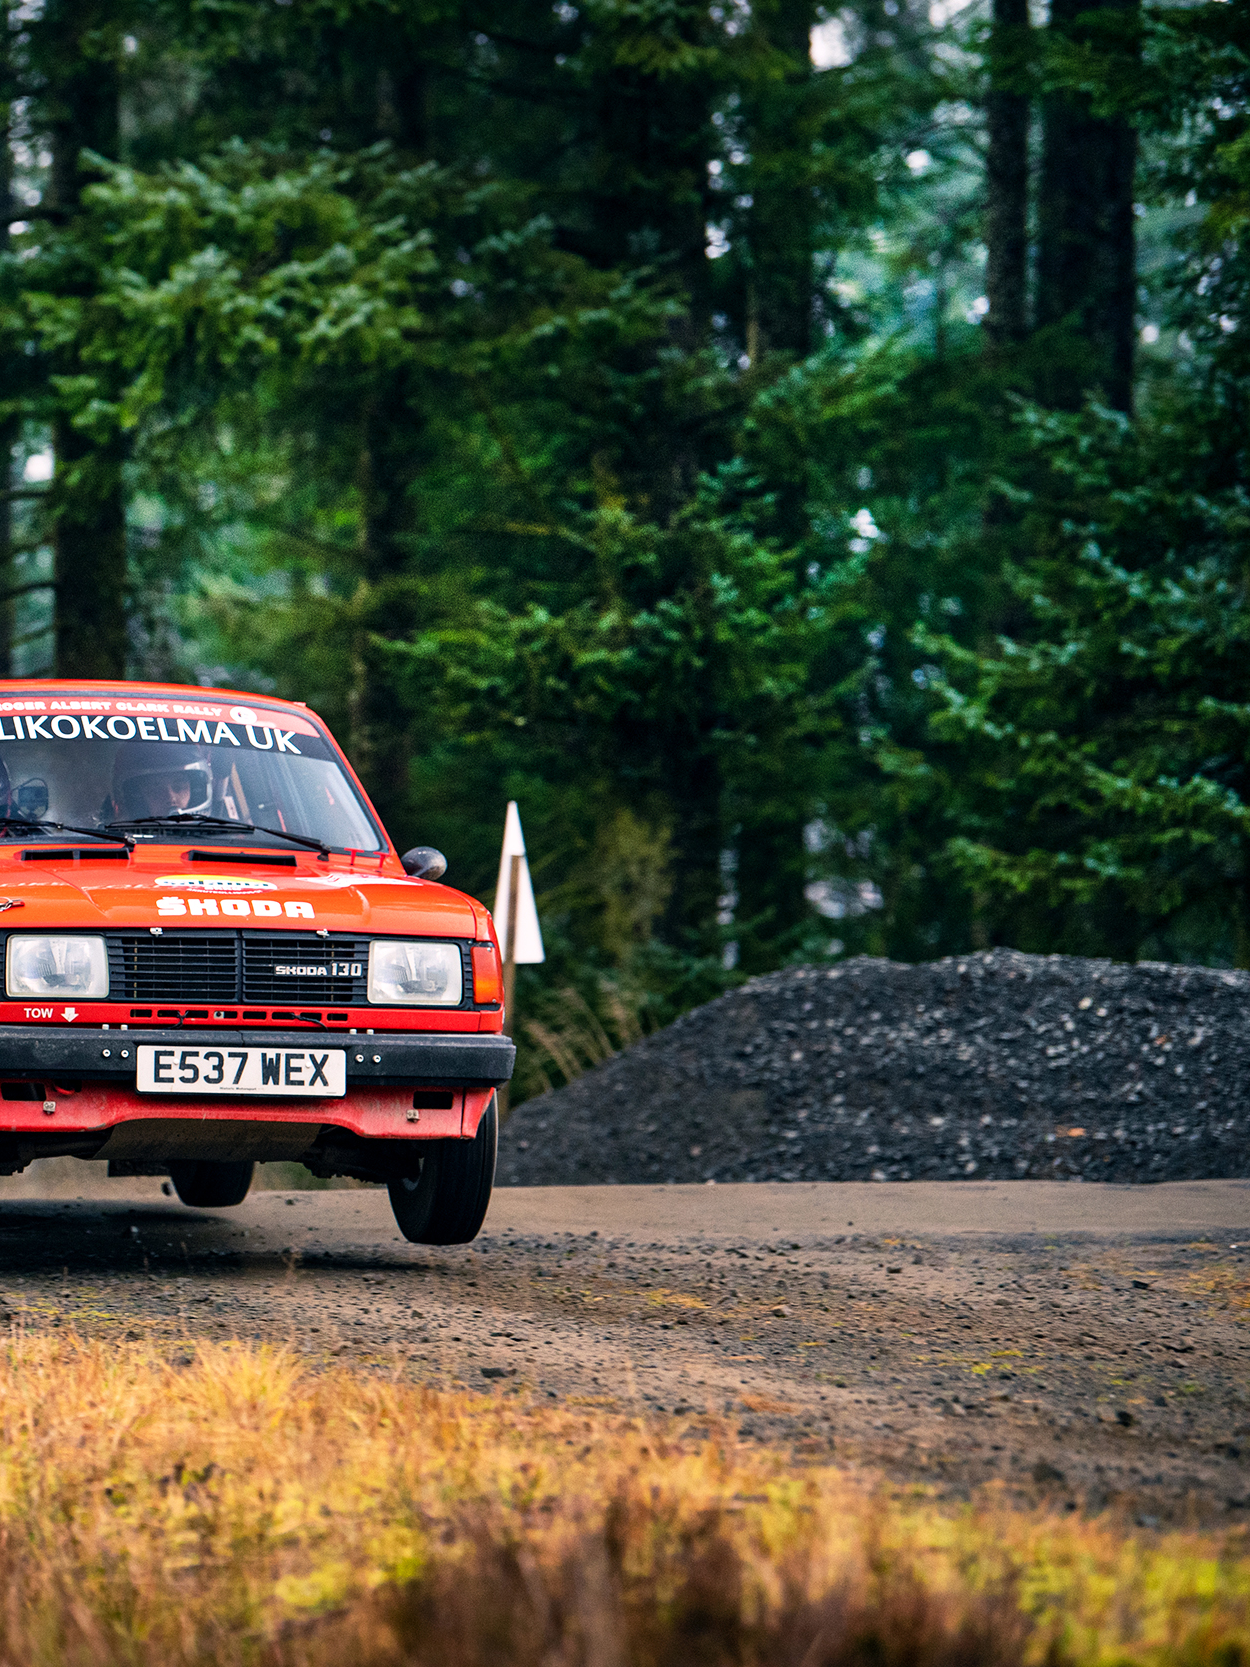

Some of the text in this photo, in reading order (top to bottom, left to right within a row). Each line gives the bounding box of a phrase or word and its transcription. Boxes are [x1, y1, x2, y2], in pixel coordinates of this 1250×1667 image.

[50, 701, 111, 711] ALBERT
[116, 702, 169, 713] CLARK
[173, 704, 223, 716] RALLY
[245, 724, 301, 755] UK
[331, 962, 363, 976] 130
[23, 1007, 54, 1019] TOW
[153, 1050, 330, 1087] E537 WEX
